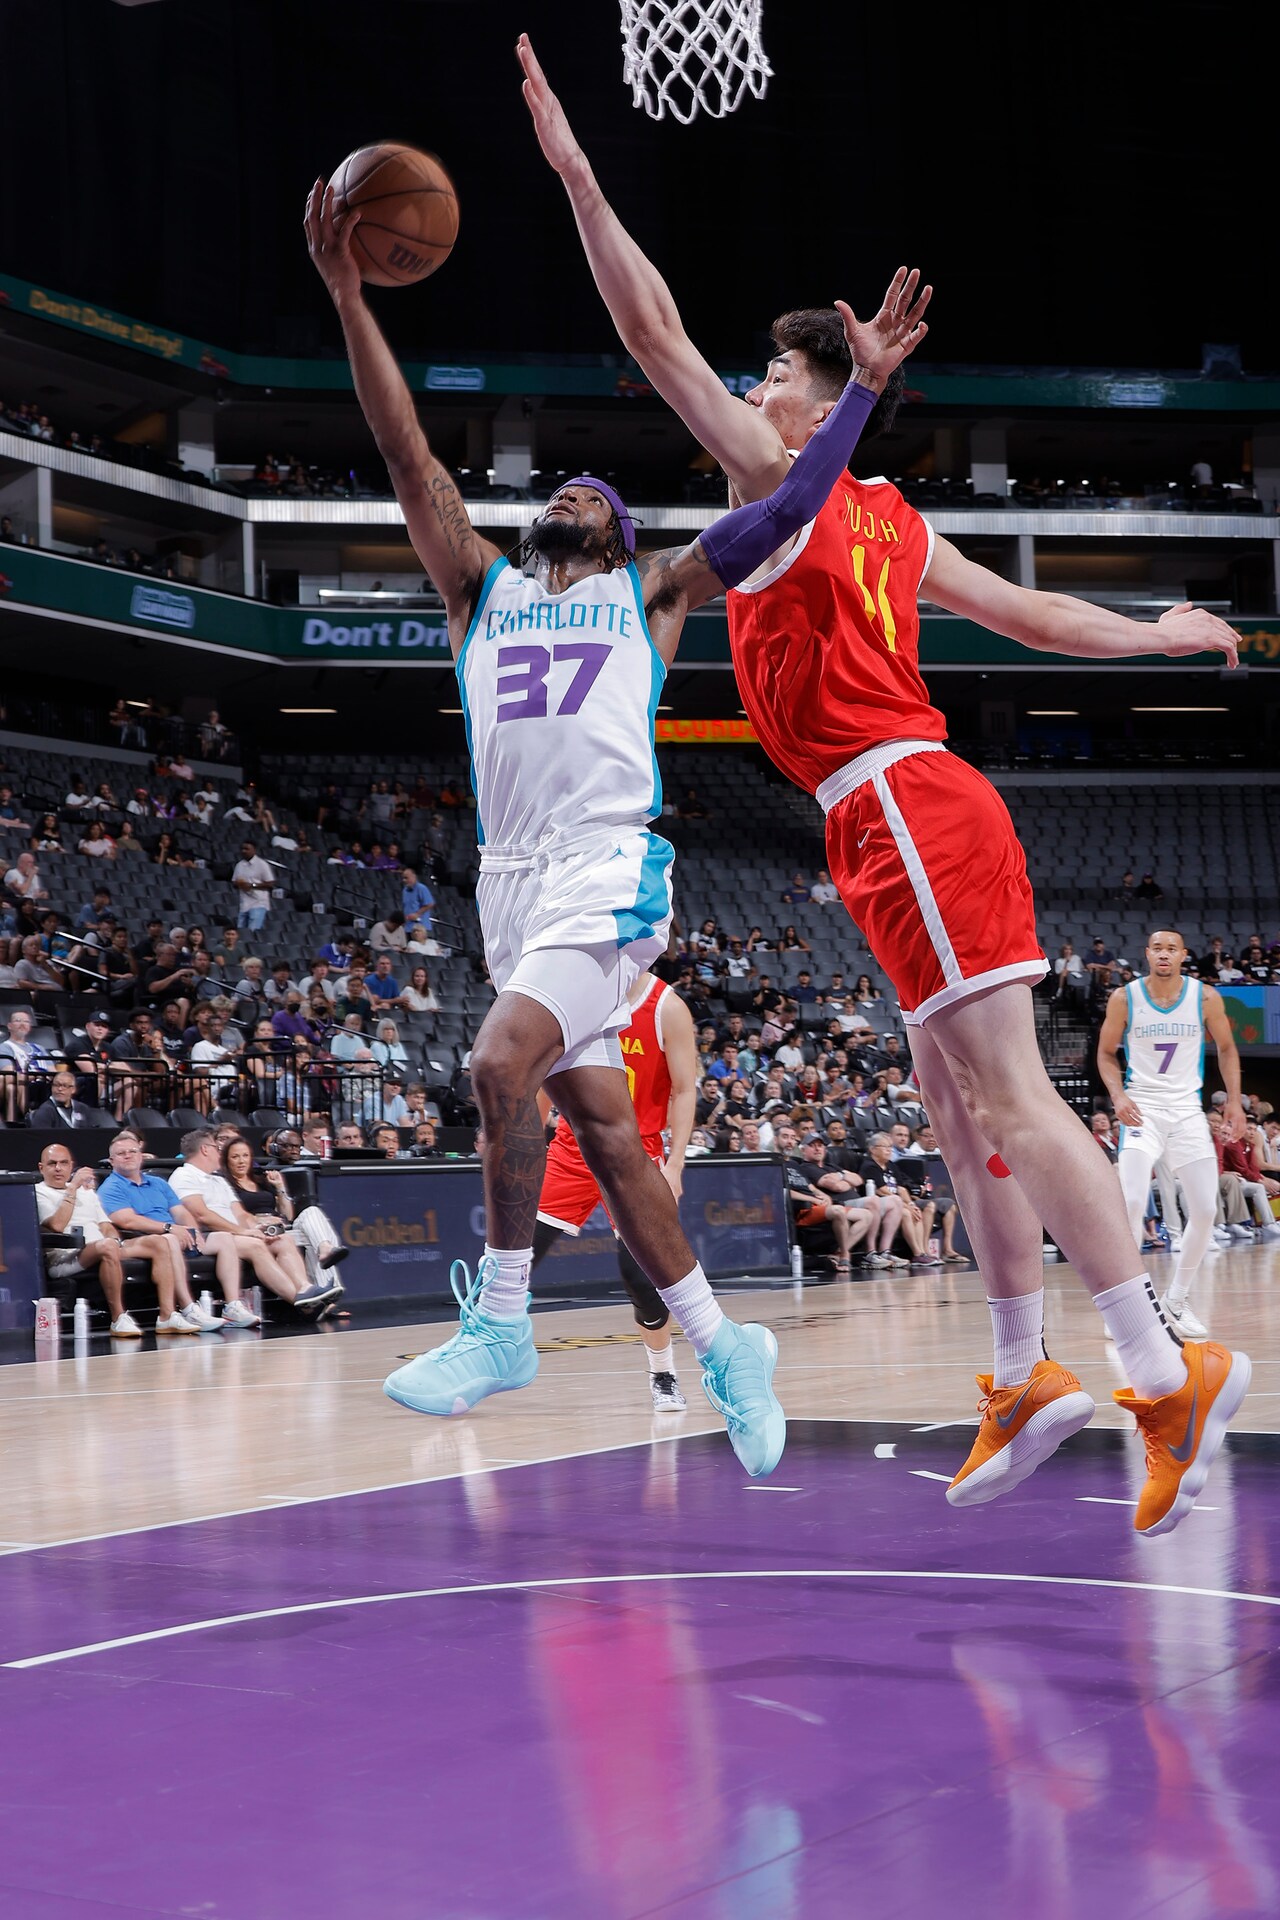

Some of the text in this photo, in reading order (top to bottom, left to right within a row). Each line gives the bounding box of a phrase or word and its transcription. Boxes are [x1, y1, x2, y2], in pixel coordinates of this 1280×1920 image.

[302, 618, 449, 647] Don't Dri
[486, 601, 632, 641] CHARLOTTE
[496, 643, 614, 724] 37
[1134, 1023, 1198, 1039] CHARLOTTE
[1153, 1043, 1179, 1074] 7
